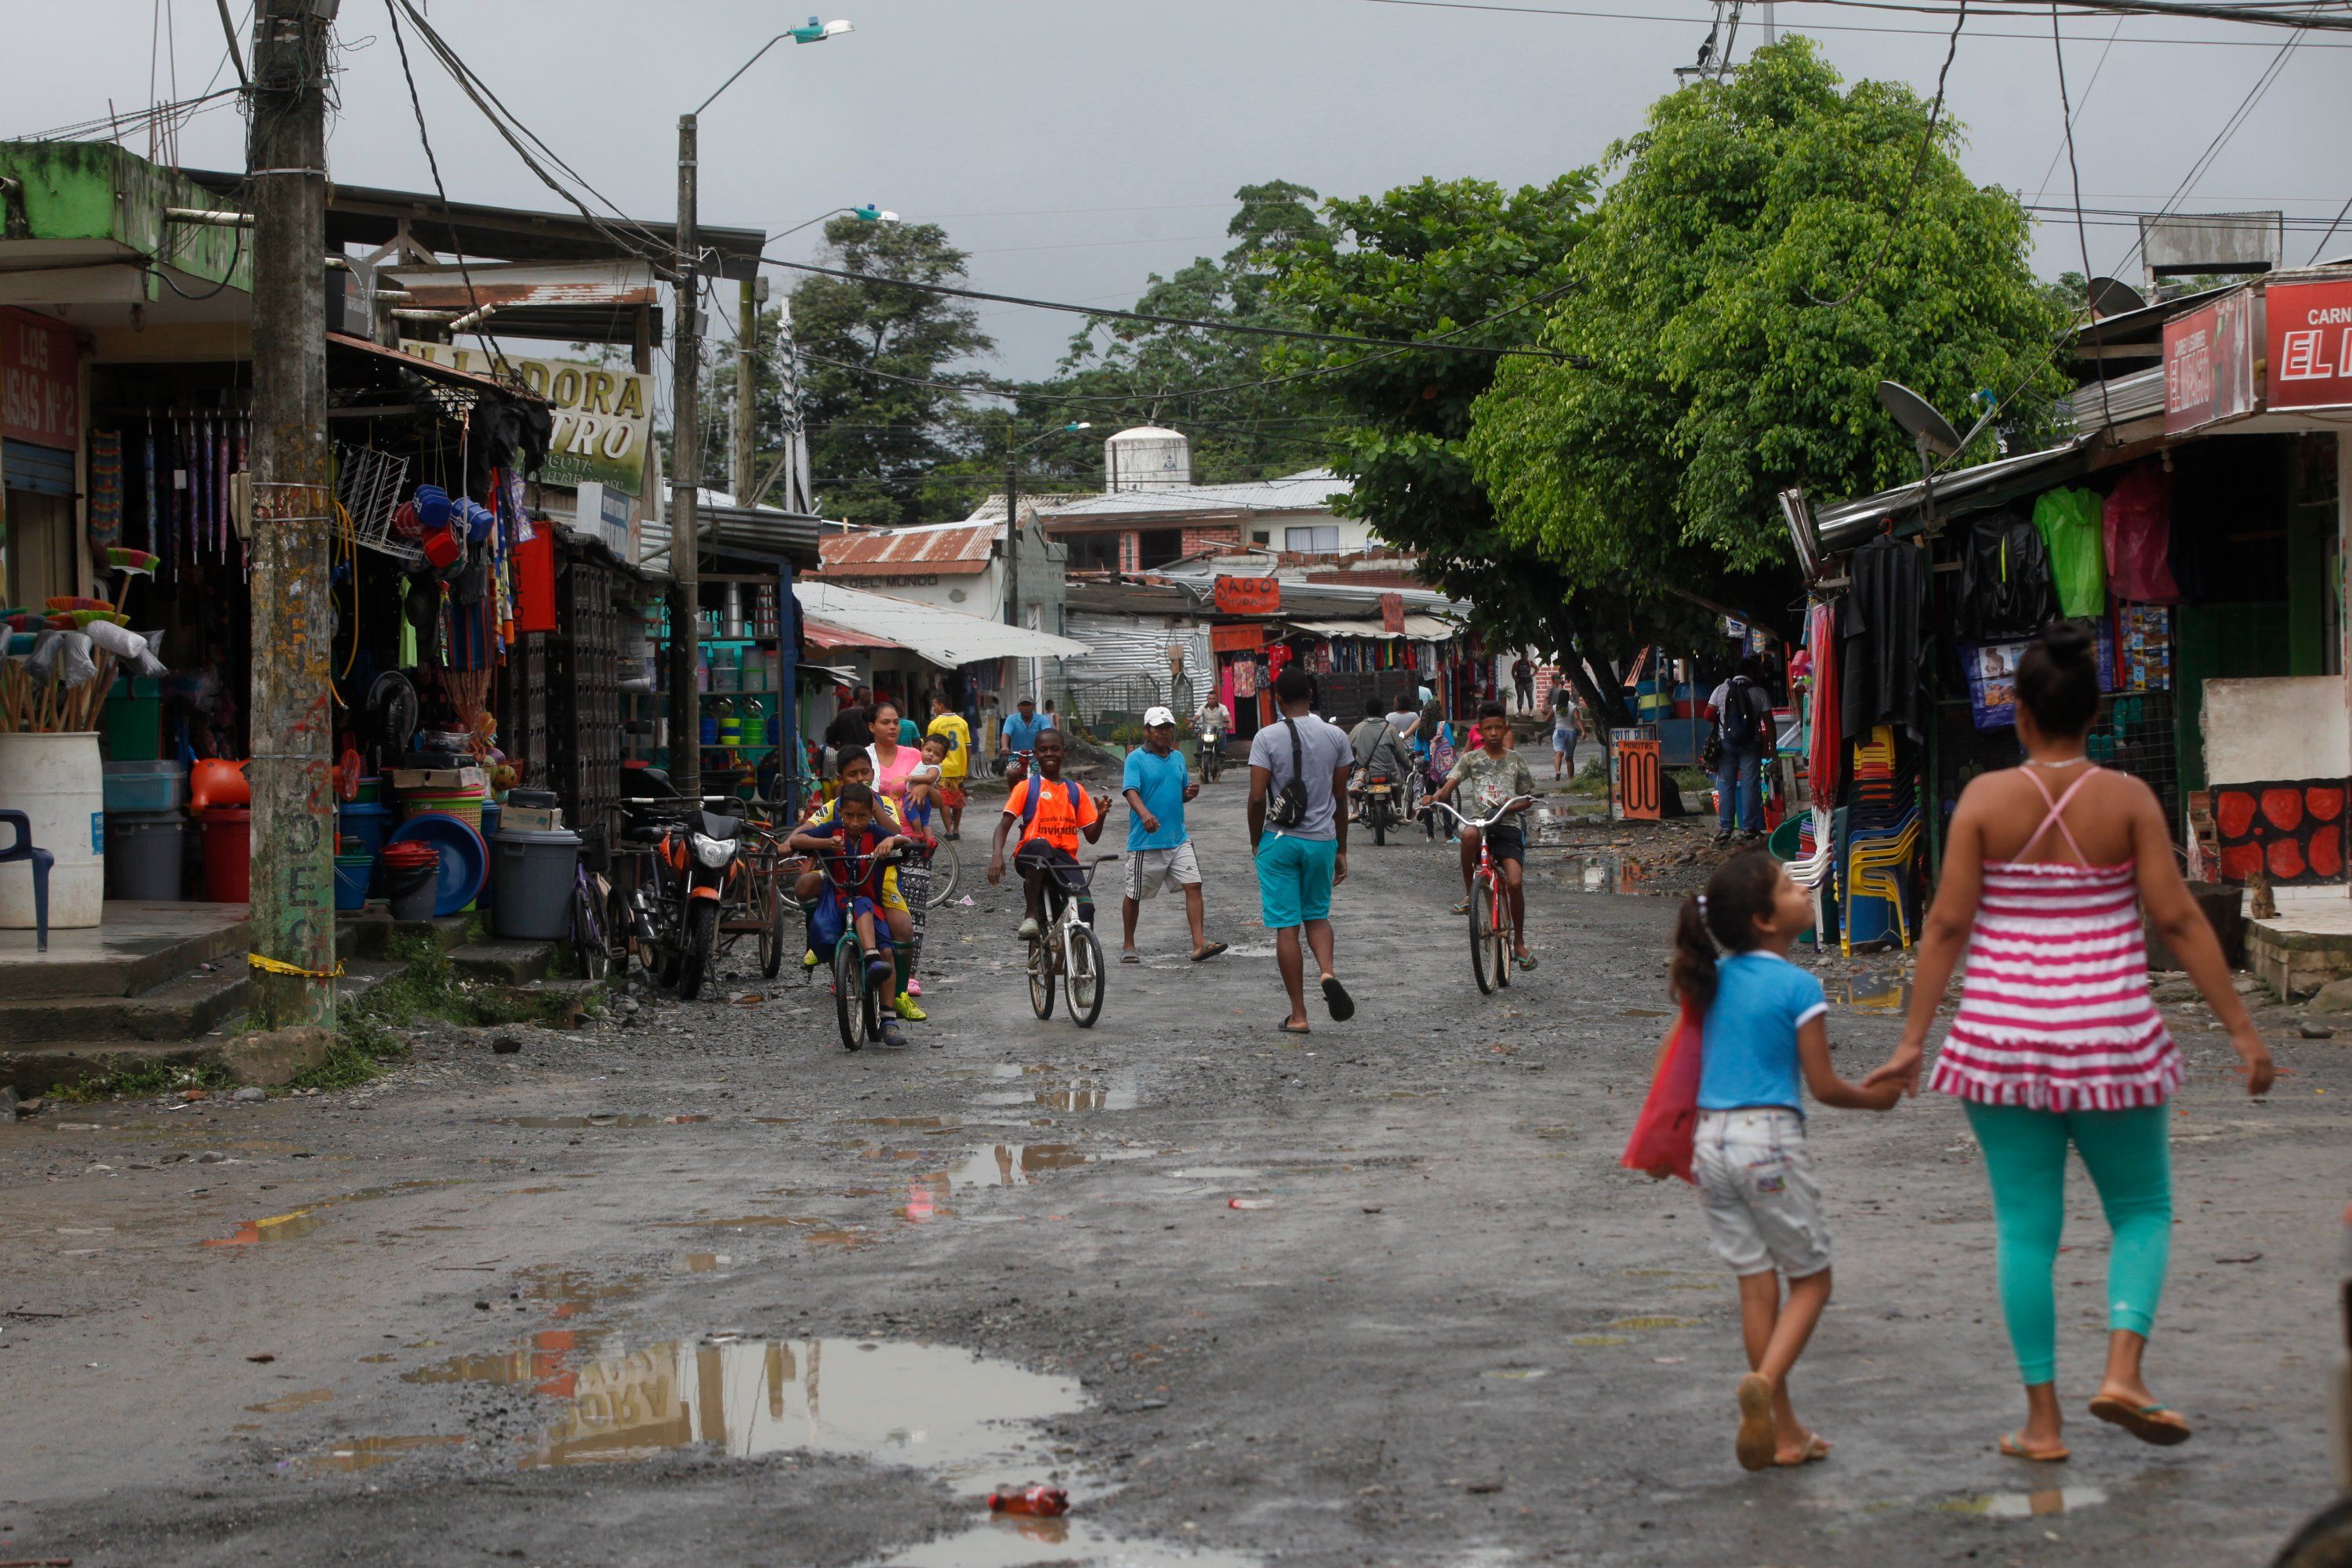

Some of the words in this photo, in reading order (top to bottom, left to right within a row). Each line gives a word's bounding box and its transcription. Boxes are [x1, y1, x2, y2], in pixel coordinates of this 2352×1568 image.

[20, 324, 49, 372] LOS
[2280, 329, 2332, 381] EL
[64, 384, 75, 436] 2
[549, 409, 635, 460] TRO
[849, 578, 880, 588] DEL
[886, 574, 938, 588] MUNDO
[1227, 596, 1267, 607] MODAS
[1624, 741, 1653, 750] MINUTOS
[1618, 750, 1659, 811] 100
